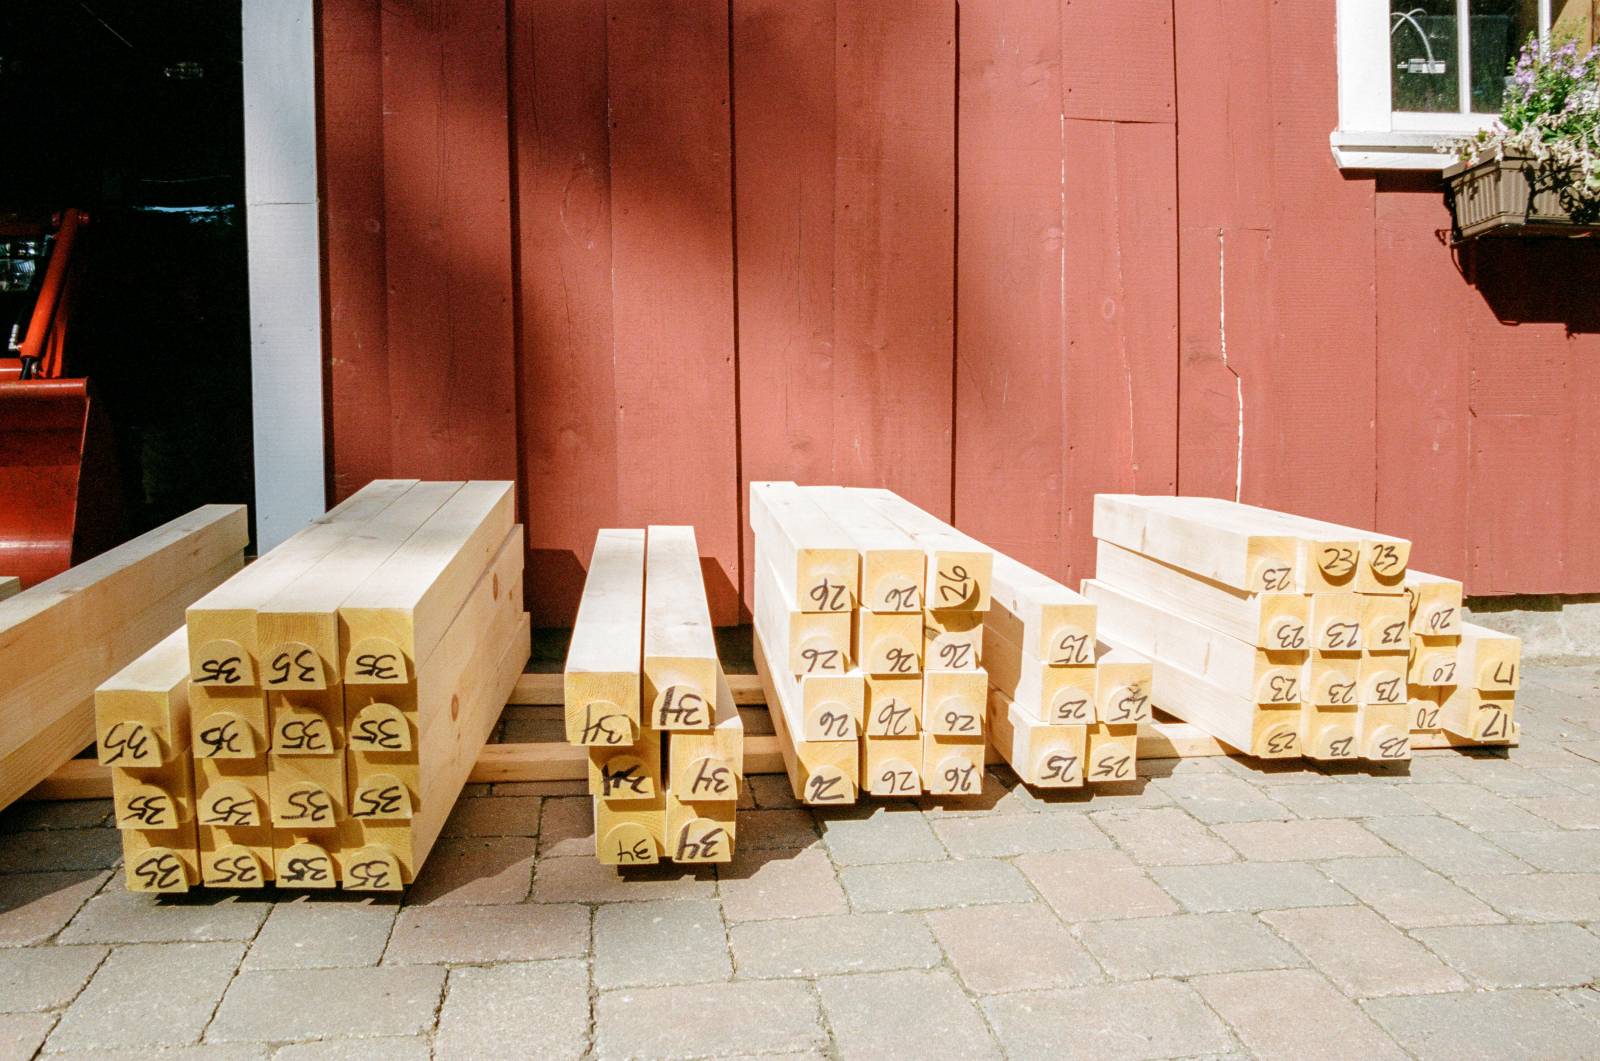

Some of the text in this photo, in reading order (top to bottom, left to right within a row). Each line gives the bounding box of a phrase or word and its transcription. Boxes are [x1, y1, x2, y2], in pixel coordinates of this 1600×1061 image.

[1324, 548, 1356, 571] 23
[1372, 544, 1399, 570] 23
[938, 565, 971, 601] 26
[1262, 568, 1292, 590] 23
[810, 578, 846, 610] 26
[885, 586, 917, 610] 26
[1431, 608, 1454, 630] 20
[1277, 625, 1304, 648] 23
[1326, 623, 1360, 648] 23
[1382, 620, 1406, 644] 23
[801, 649, 838, 672] 26
[886, 648, 914, 672] 26
[940, 643, 971, 668] 26
[1055, 635, 1088, 663] 25
[193, 657, 241, 683] 35
[262, 649, 315, 684] 35
[356, 654, 399, 679] 35
[1433, 662, 1456, 681] 20
[1494, 662, 1514, 685] 17
[1270, 676, 1296, 702] 23
[1328, 682, 1356, 704] 23
[1376, 677, 1400, 702] 23
[659, 686, 702, 726] 34
[878, 698, 911, 735] 26
[1058, 700, 1087, 719] 25
[1111, 696, 1148, 721] 25
[1416, 708, 1439, 728] 20
[352, 718, 402, 749] 35
[581, 703, 628, 744] 34
[819, 712, 848, 737] 26
[945, 711, 974, 731] 26
[1481, 710, 1508, 738] 17
[104, 722, 148, 765] 35
[281, 719, 325, 749] 35
[1268, 732, 1296, 754] 23
[1330, 736, 1353, 757] 23
[1380, 738, 1409, 758] 23
[692, 758, 729, 793] 34
[944, 764, 975, 791] 26
[1041, 756, 1077, 782] 25
[1091, 756, 1130, 778] 25
[881, 771, 915, 793] 26
[123, 795, 166, 824] 35
[203, 797, 256, 825] 35
[281, 790, 329, 821] 35
[353, 786, 402, 817] 35
[617, 839, 651, 862] 34
[675, 825, 723, 860] 34
[135, 854, 180, 888] 35
[207, 856, 257, 884] 35
[280, 857, 327, 882] 35
[342, 860, 390, 890] 35
